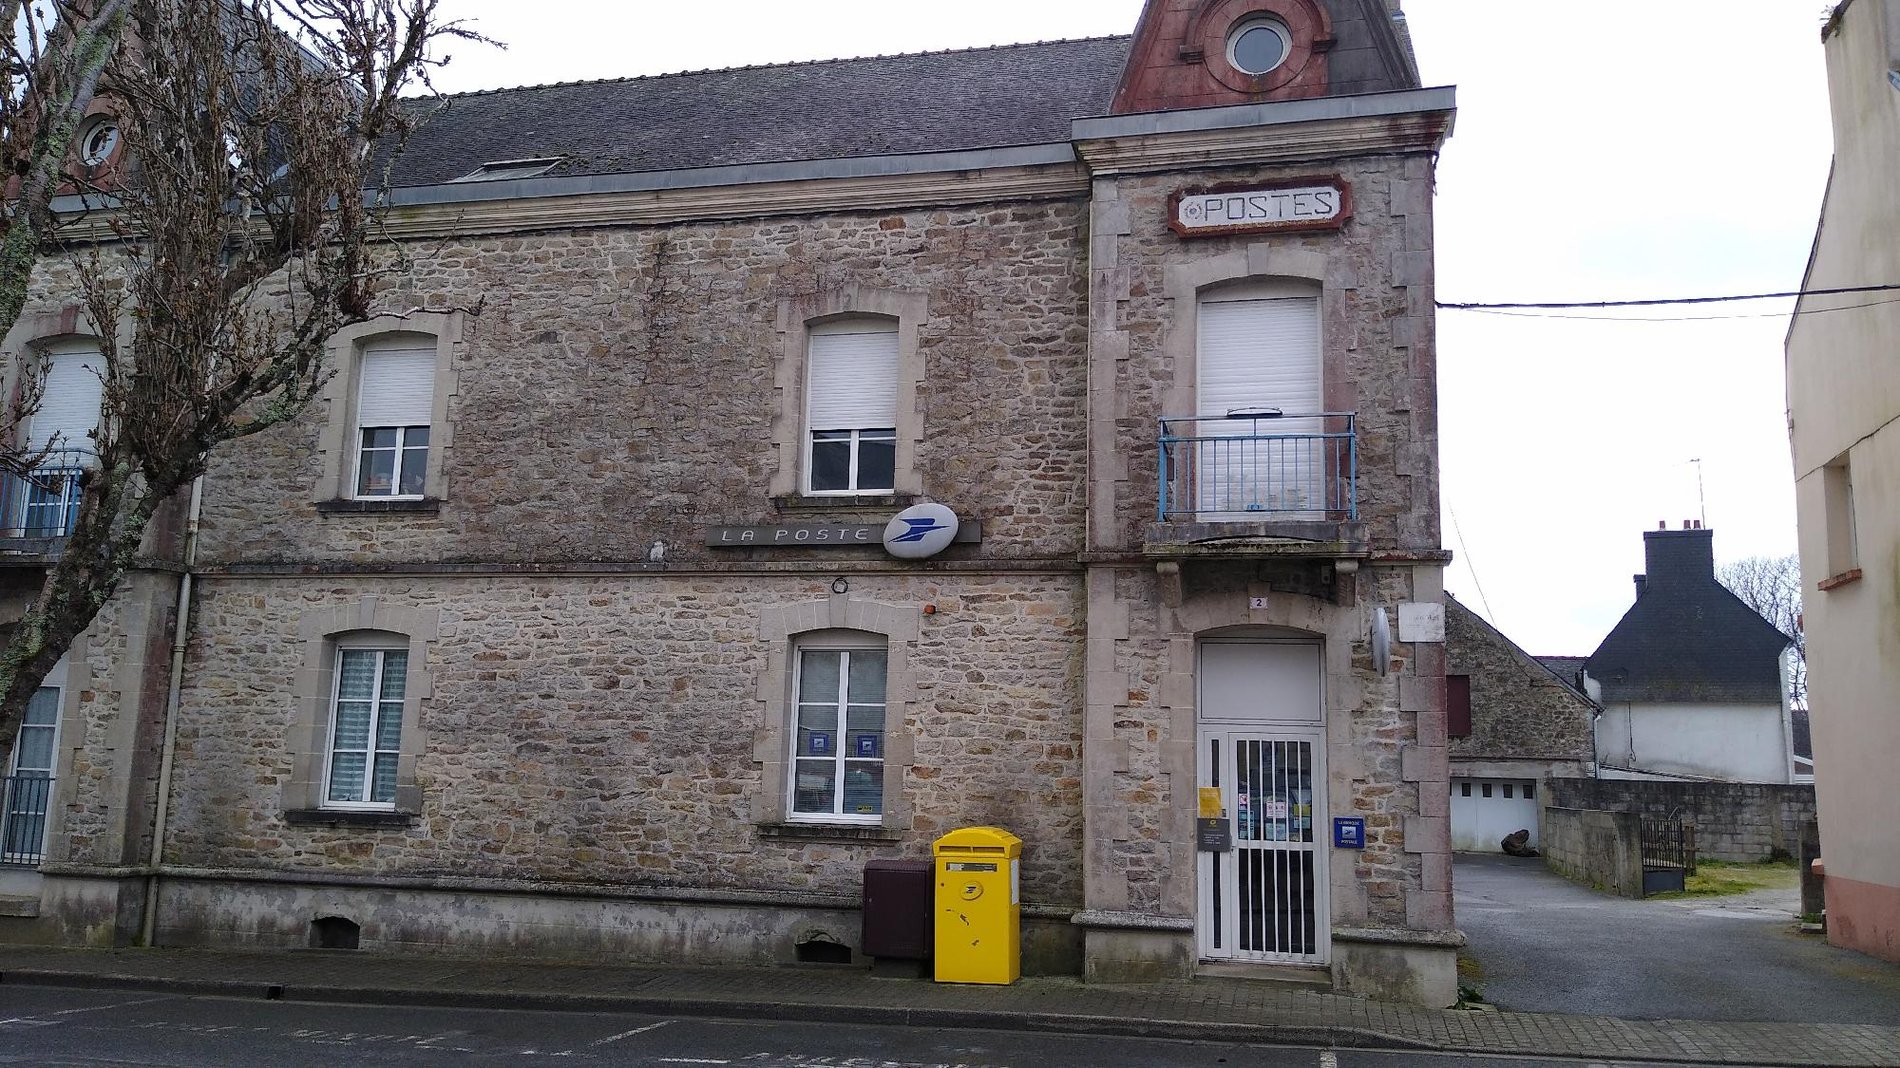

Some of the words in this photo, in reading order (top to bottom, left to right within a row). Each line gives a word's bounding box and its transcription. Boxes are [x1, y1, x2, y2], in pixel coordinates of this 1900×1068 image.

[1205, 192, 1333, 221] POSTES
[721, 530, 754, 541] LA
[774, 528, 869, 541] POSTE
